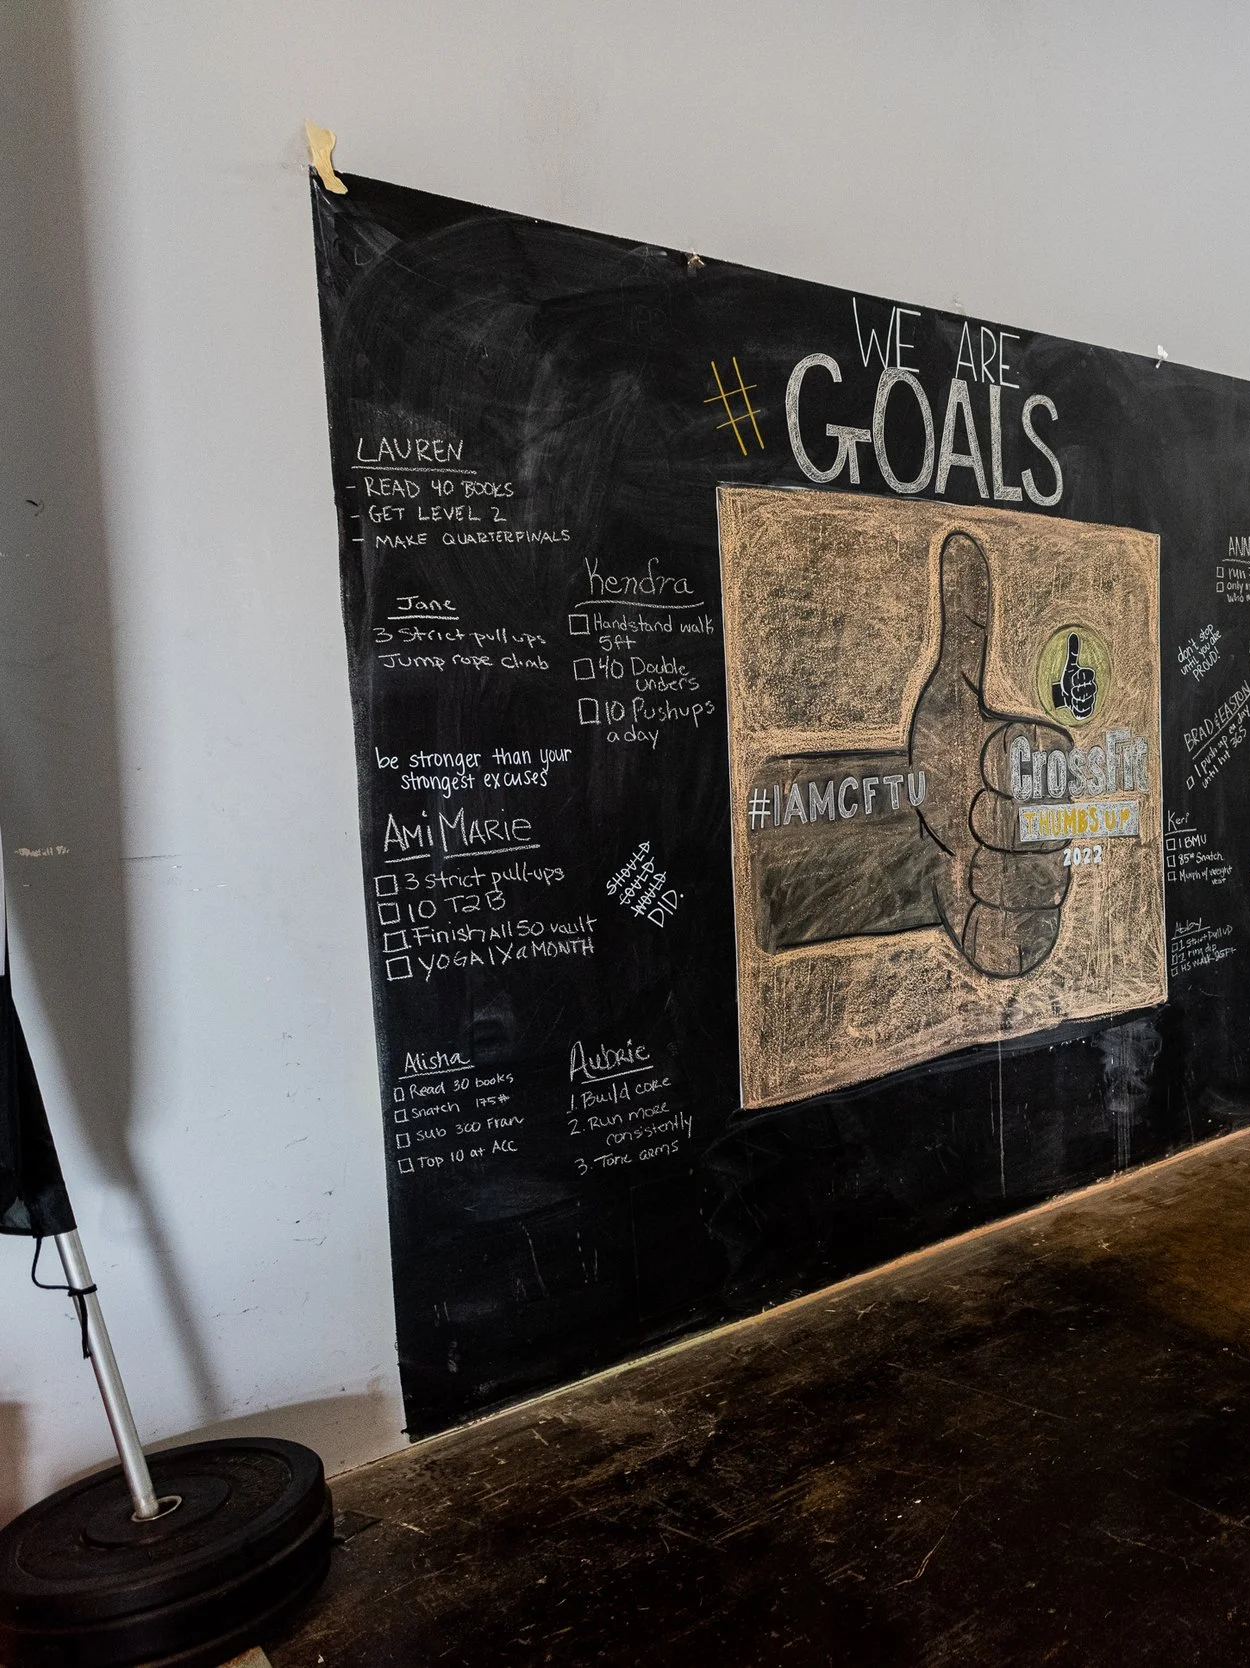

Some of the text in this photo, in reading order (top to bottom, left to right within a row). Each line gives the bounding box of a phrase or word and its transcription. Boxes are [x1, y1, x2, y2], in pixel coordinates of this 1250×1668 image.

[852, 297, 1020, 389] WE ARE
[785, 353, 1063, 506] GOALS
[357, 438, 464, 462] LAUREN
[365, 478, 514, 498] READ 40 BOOKS
[369, 506, 507, 523] GET LEVEL 2
[376, 529, 570, 549] MAKE QUARTERFINALS
[1228, 537, 1250, 556] ANN
[584, 557, 694, 595] Kendra
[1228, 568, 1246, 579] run
[397, 596, 456, 611] Jane
[594, 615, 714, 635] Handstand walk
[373, 628, 392, 642] 3
[474, 628, 507, 646] pull
[513, 633, 546, 646] ups
[599, 636, 636, 651] 5ft
[1178, 624, 1213, 663] don't stop
[378, 654, 549, 671] Jump rope climb
[599, 657, 689, 679] 40 Double
[1181, 657, 1200, 676] until
[1199, 643, 1211, 659] you
[1192, 647, 1221, 682] PROUD!
[606, 698, 714, 728] 10 Pushups
[607, 726, 659, 749] a day
[1184, 718, 1214, 752] BRAD
[1201, 746, 1218, 774] push
[1237, 705, 1250, 724] day
[1230, 726, 1246, 748] 365
[375, 747, 572, 776] be stronger than your
[1010, 728, 1149, 800] CrossFit
[401, 769, 548, 798] strongest excuses
[749, 770, 927, 830] #IAMCFTU
[1024, 807, 1130, 836] THUMBS UP
[1168, 810, 1189, 831] Keri
[1185, 835, 1207, 848] BMU
[1064, 845, 1102, 866] 2022
[404, 862, 565, 892] 3 strict pull-ups
[607, 841, 650, 895] SHOULD
[620, 857, 655, 905] COULD
[631, 871, 666, 917] WOULD
[408, 900, 436, 922] 10
[412, 922, 486, 946] Finish
[517, 920, 544, 936] 50
[531, 937, 594, 957] MONTH
[1205, 943, 1216, 953] dip
[1181, 964, 1191, 973] HS
[404, 1052, 470, 1074] Alisha
[409, 1072, 514, 1096] Read 30 books
[582, 1083, 631, 1106] Build
[488, 1116, 524, 1132] Fran
[569, 1119, 586, 1135] 2.
[590, 1114, 622, 1131] Run
[417, 1156, 444, 1170] Top
[451, 1151, 464, 1162] 10
[470, 1148, 486, 1158] at
[574, 1159, 592, 1175] 3.
